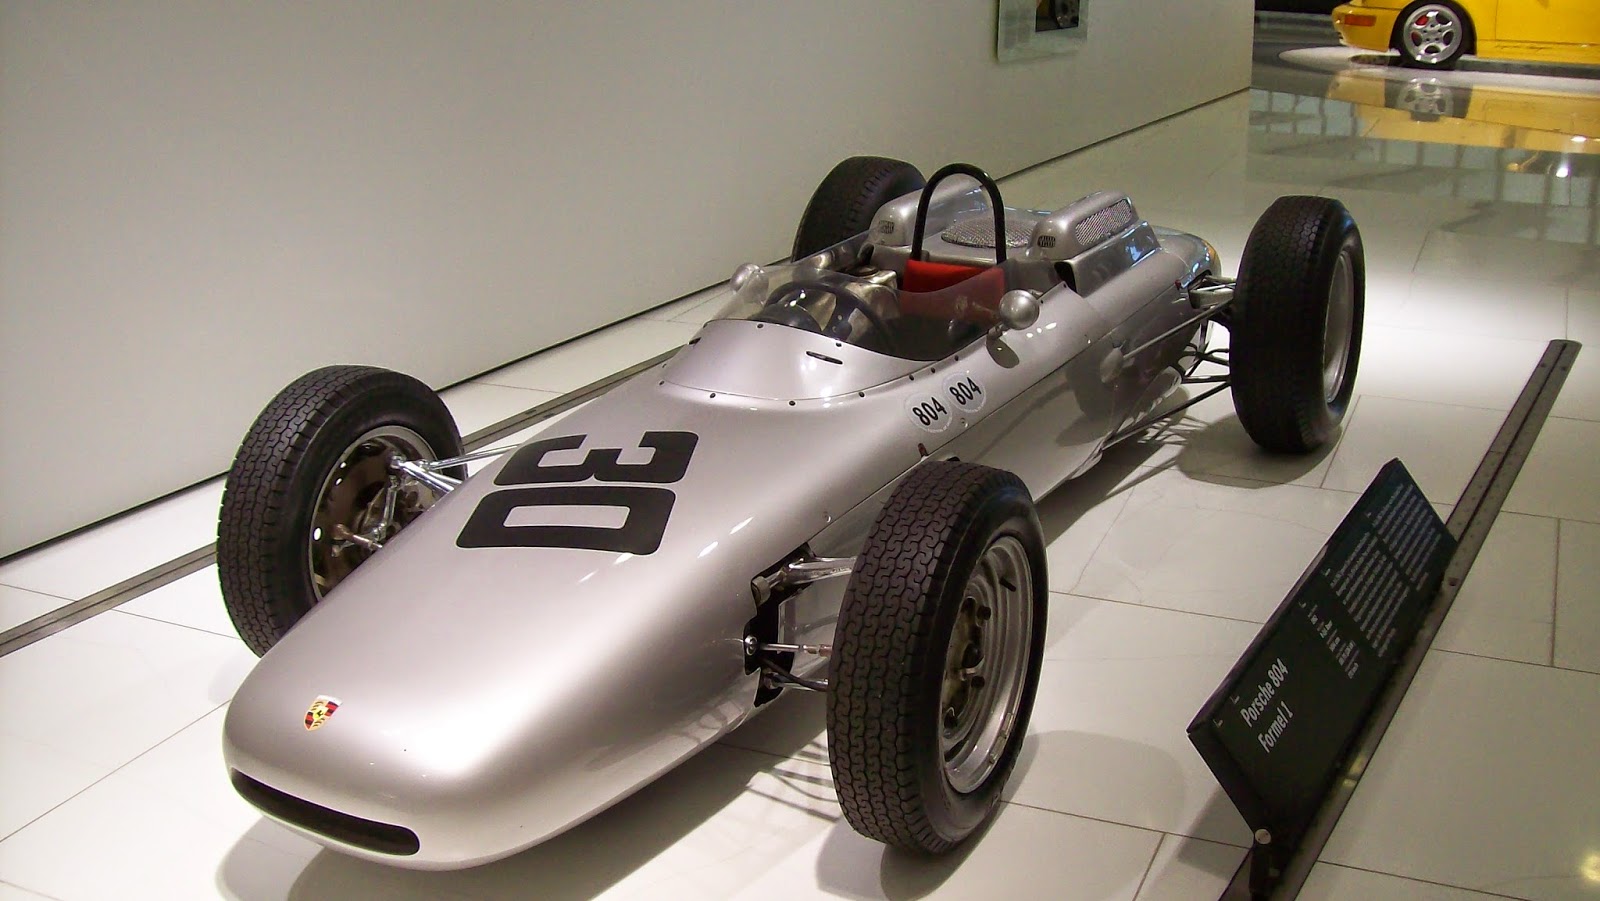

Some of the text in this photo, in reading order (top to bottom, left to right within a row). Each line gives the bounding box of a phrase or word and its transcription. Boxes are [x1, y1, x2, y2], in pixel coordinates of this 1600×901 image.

[912, 396, 948, 426] 804
[949, 376, 982, 405] 804
[456, 431, 699, 556] 30
[1240, 658, 1289, 728] Porsche 804
[1258, 700, 1294, 753] Formel 1
